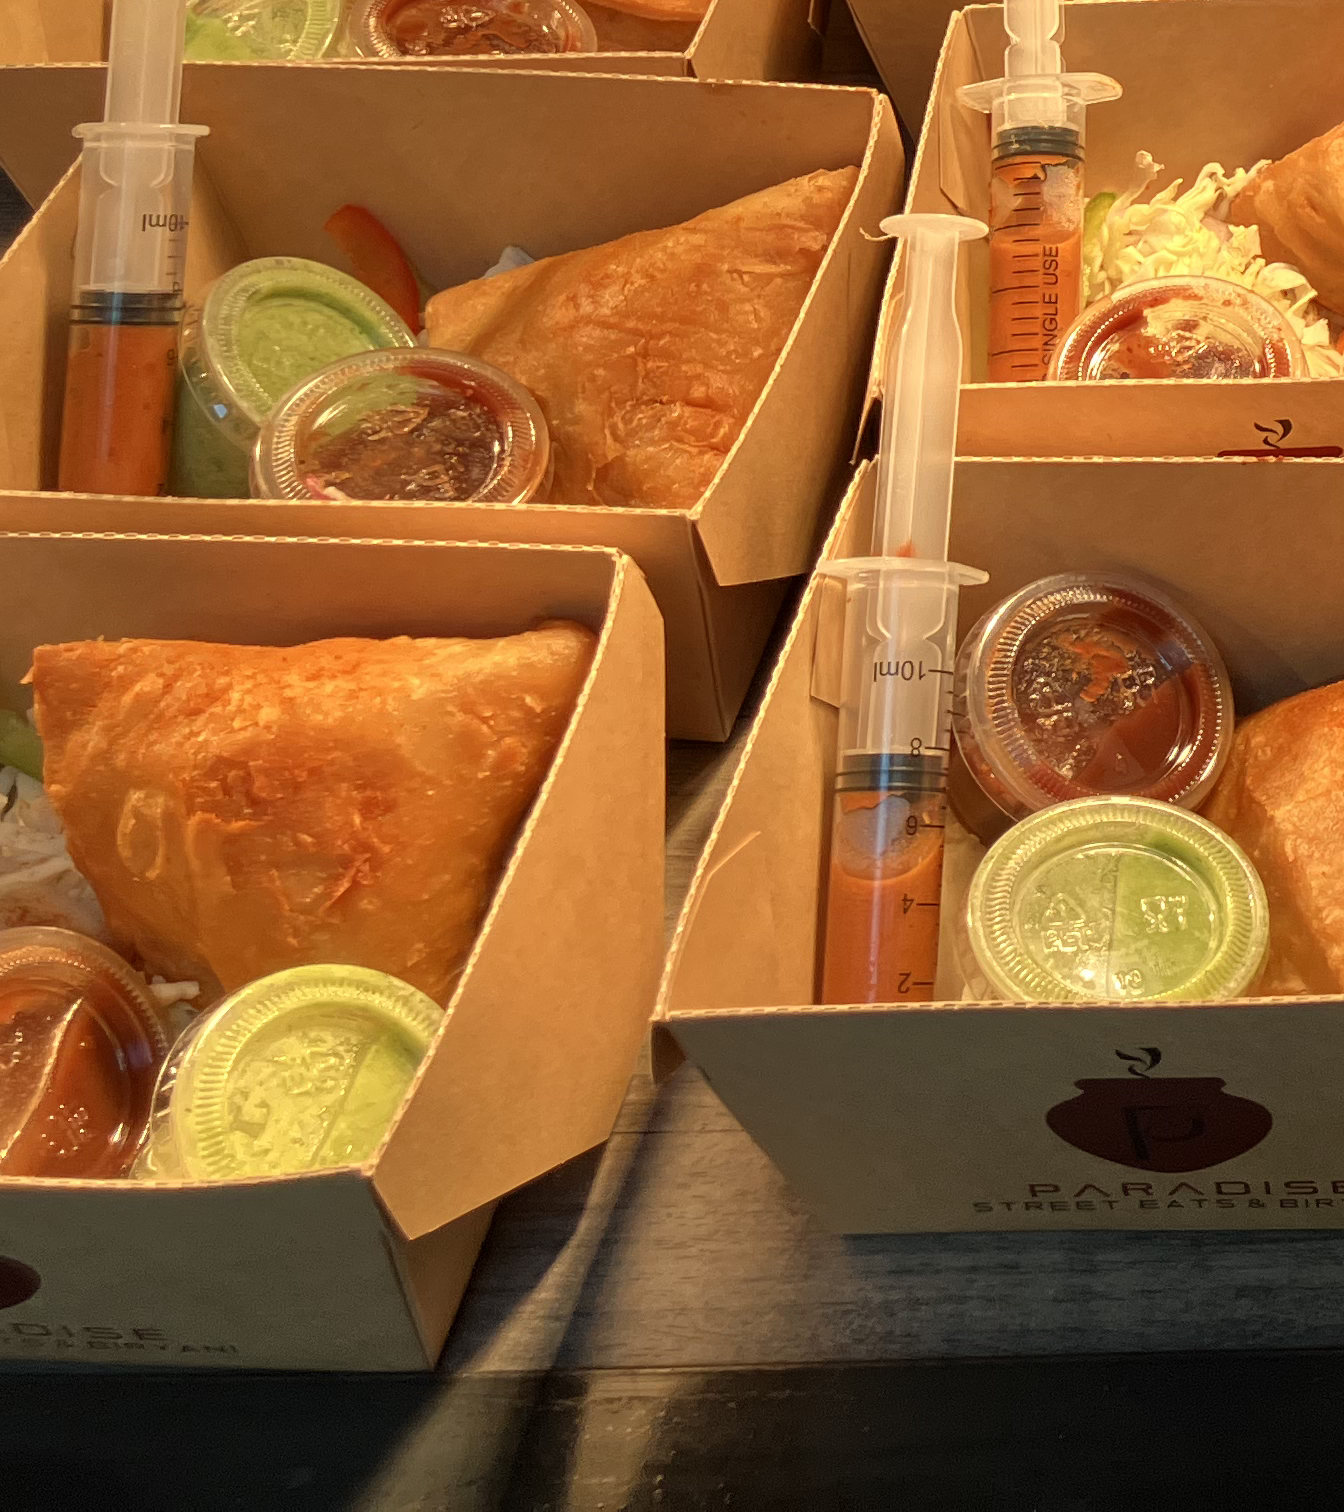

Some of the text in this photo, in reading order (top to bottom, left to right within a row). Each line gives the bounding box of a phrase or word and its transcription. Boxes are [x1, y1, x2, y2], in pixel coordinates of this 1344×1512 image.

[1042, 244, 1059, 286] USE
[872, 660, 926, 682] 10ml
[909, 737, 923, 758] 8
[972, 1199, 1120, 1213] STREET
